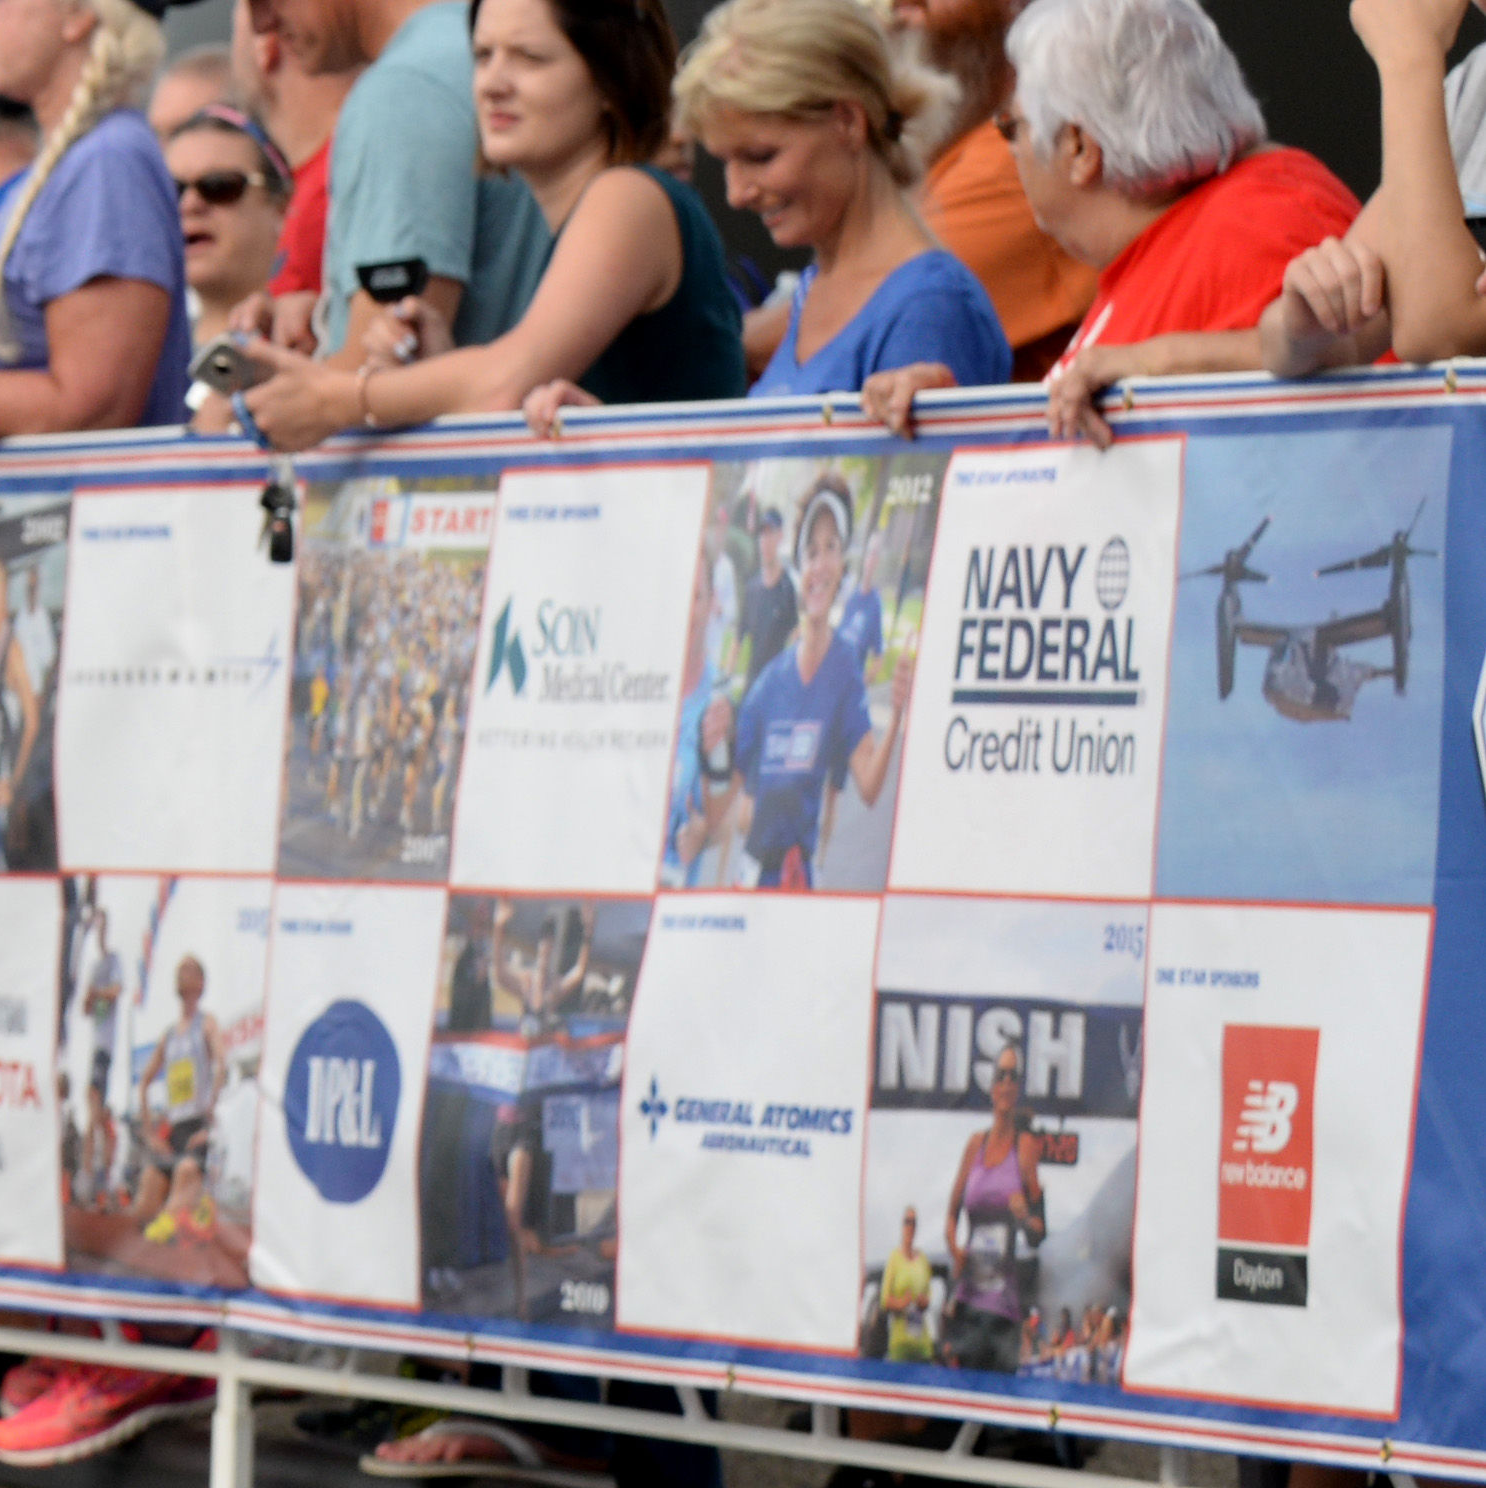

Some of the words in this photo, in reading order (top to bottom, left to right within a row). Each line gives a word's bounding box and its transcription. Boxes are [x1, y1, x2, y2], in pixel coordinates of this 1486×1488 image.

[962, 544, 1088, 611] NAVY
[954, 616, 1140, 682] FEDERAL
[944, 715, 1043, 773] Credit
[1052, 716, 1136, 775] Union
[760, 1102, 854, 1135] ATOMICS
[1221, 1162, 1245, 1185] new
[1246, 1159, 1307, 1191] balance
[1233, 1257, 1283, 1294] Dayton
